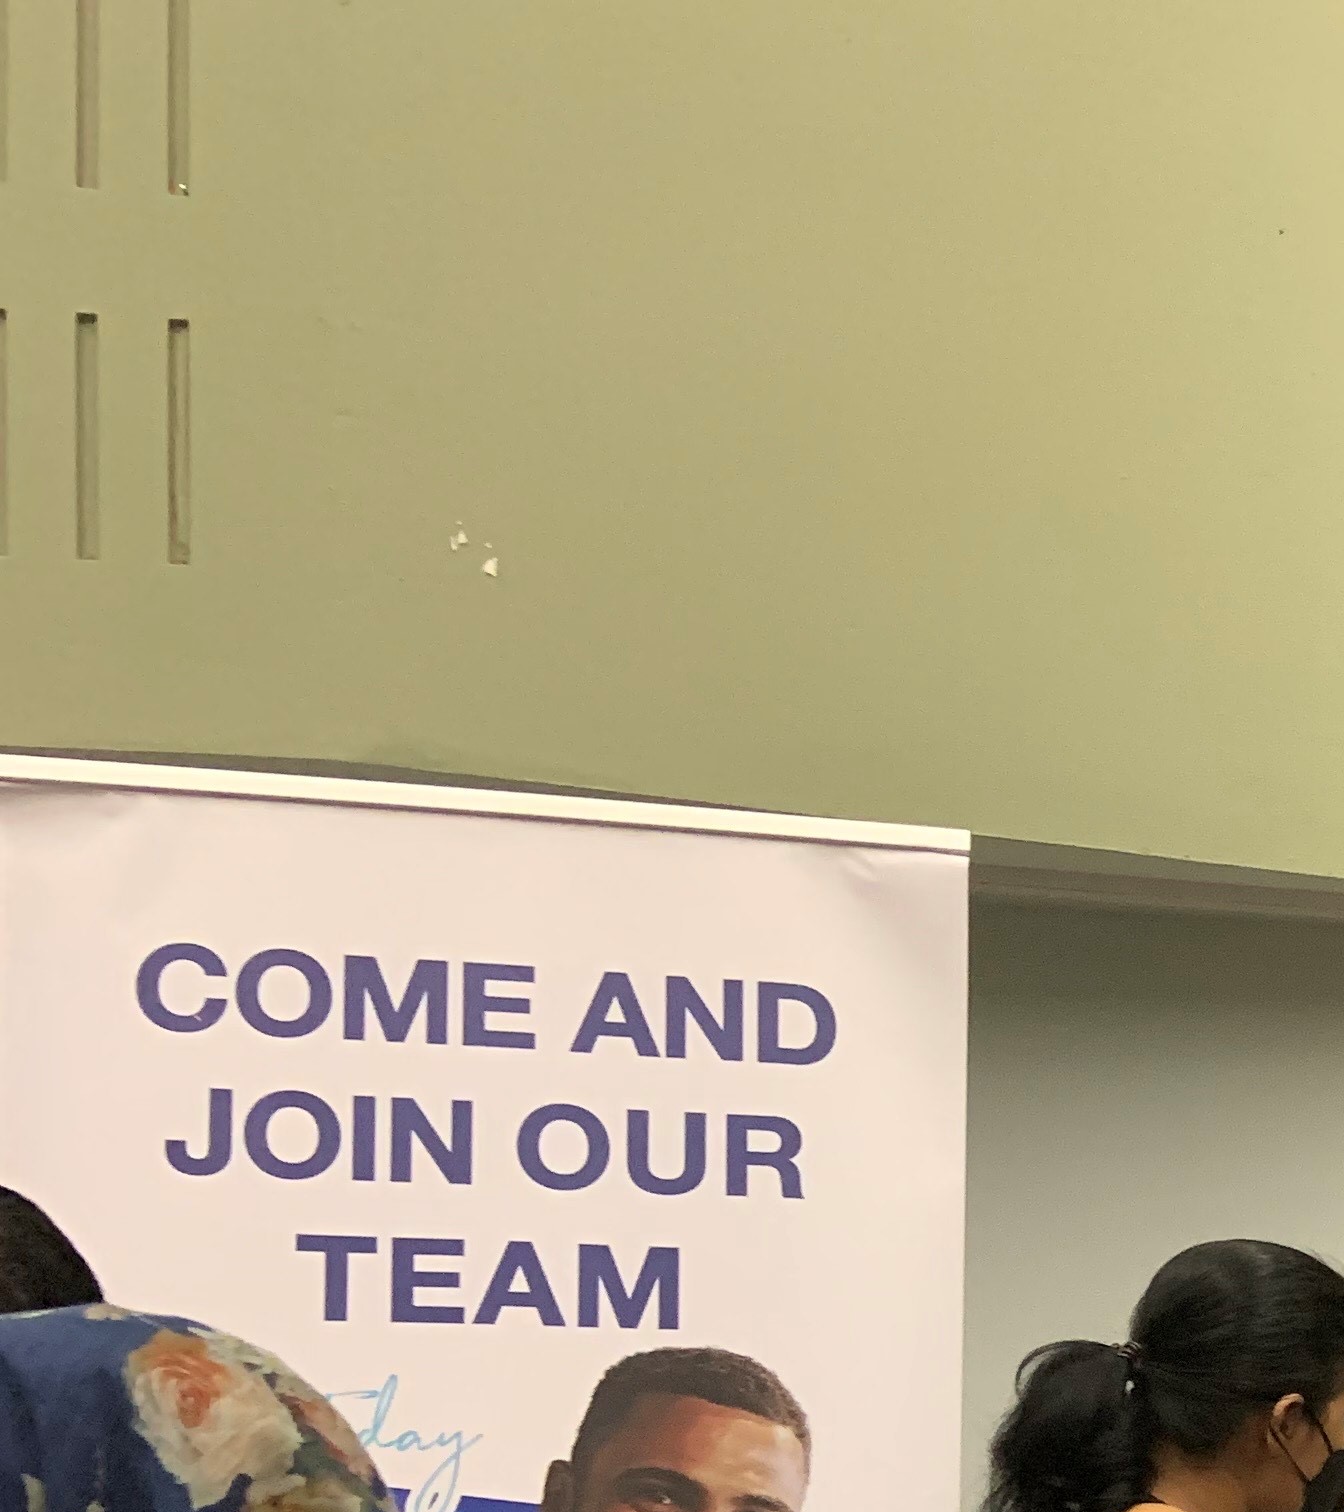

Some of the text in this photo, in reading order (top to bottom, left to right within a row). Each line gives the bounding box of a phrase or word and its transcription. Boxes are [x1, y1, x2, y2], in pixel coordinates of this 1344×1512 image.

[135, 941, 838, 1066] COME AND
[164, 1087, 805, 1200] JOIN OUR
[295, 1232, 682, 1331] TEAM
